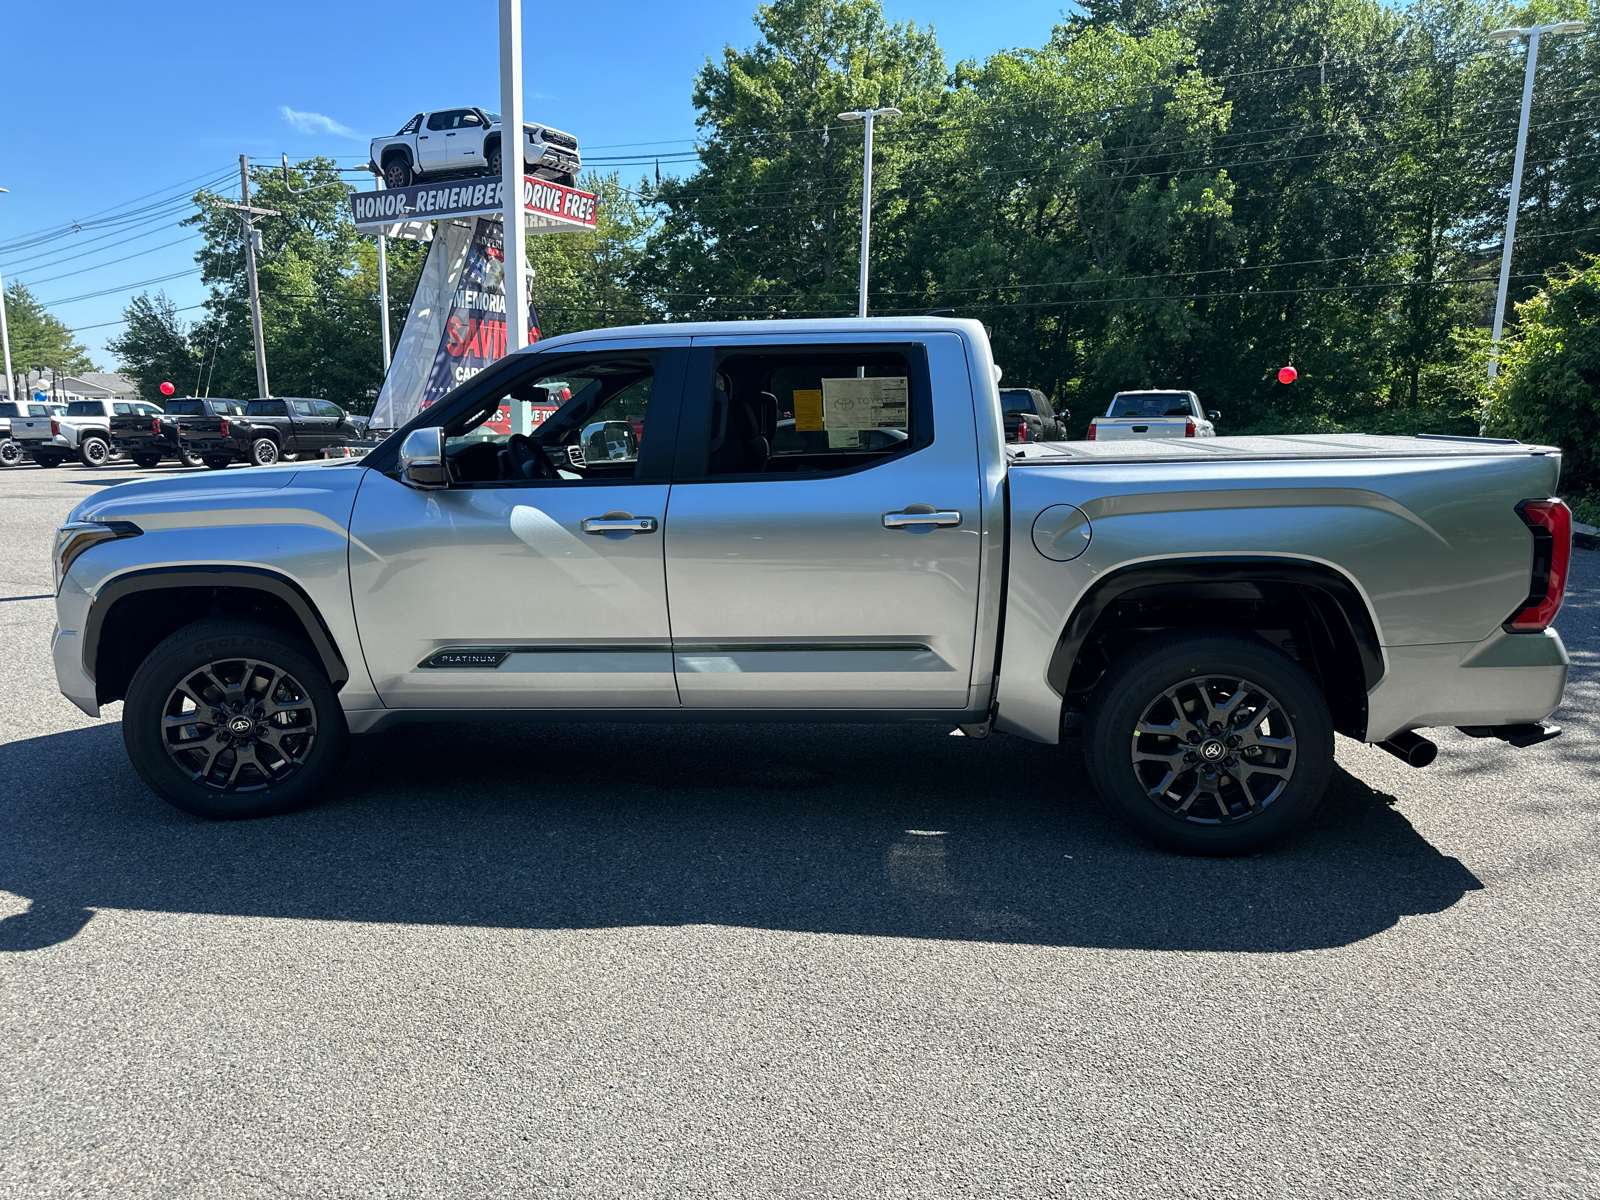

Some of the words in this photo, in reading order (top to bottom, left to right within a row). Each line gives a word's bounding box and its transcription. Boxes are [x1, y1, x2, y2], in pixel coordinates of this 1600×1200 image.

[415, 182, 503, 213] REMEMBER
[524, 181, 562, 213] DRIVE
[563, 192, 594, 221] FREE
[453, 289, 506, 314] MEMORIA
